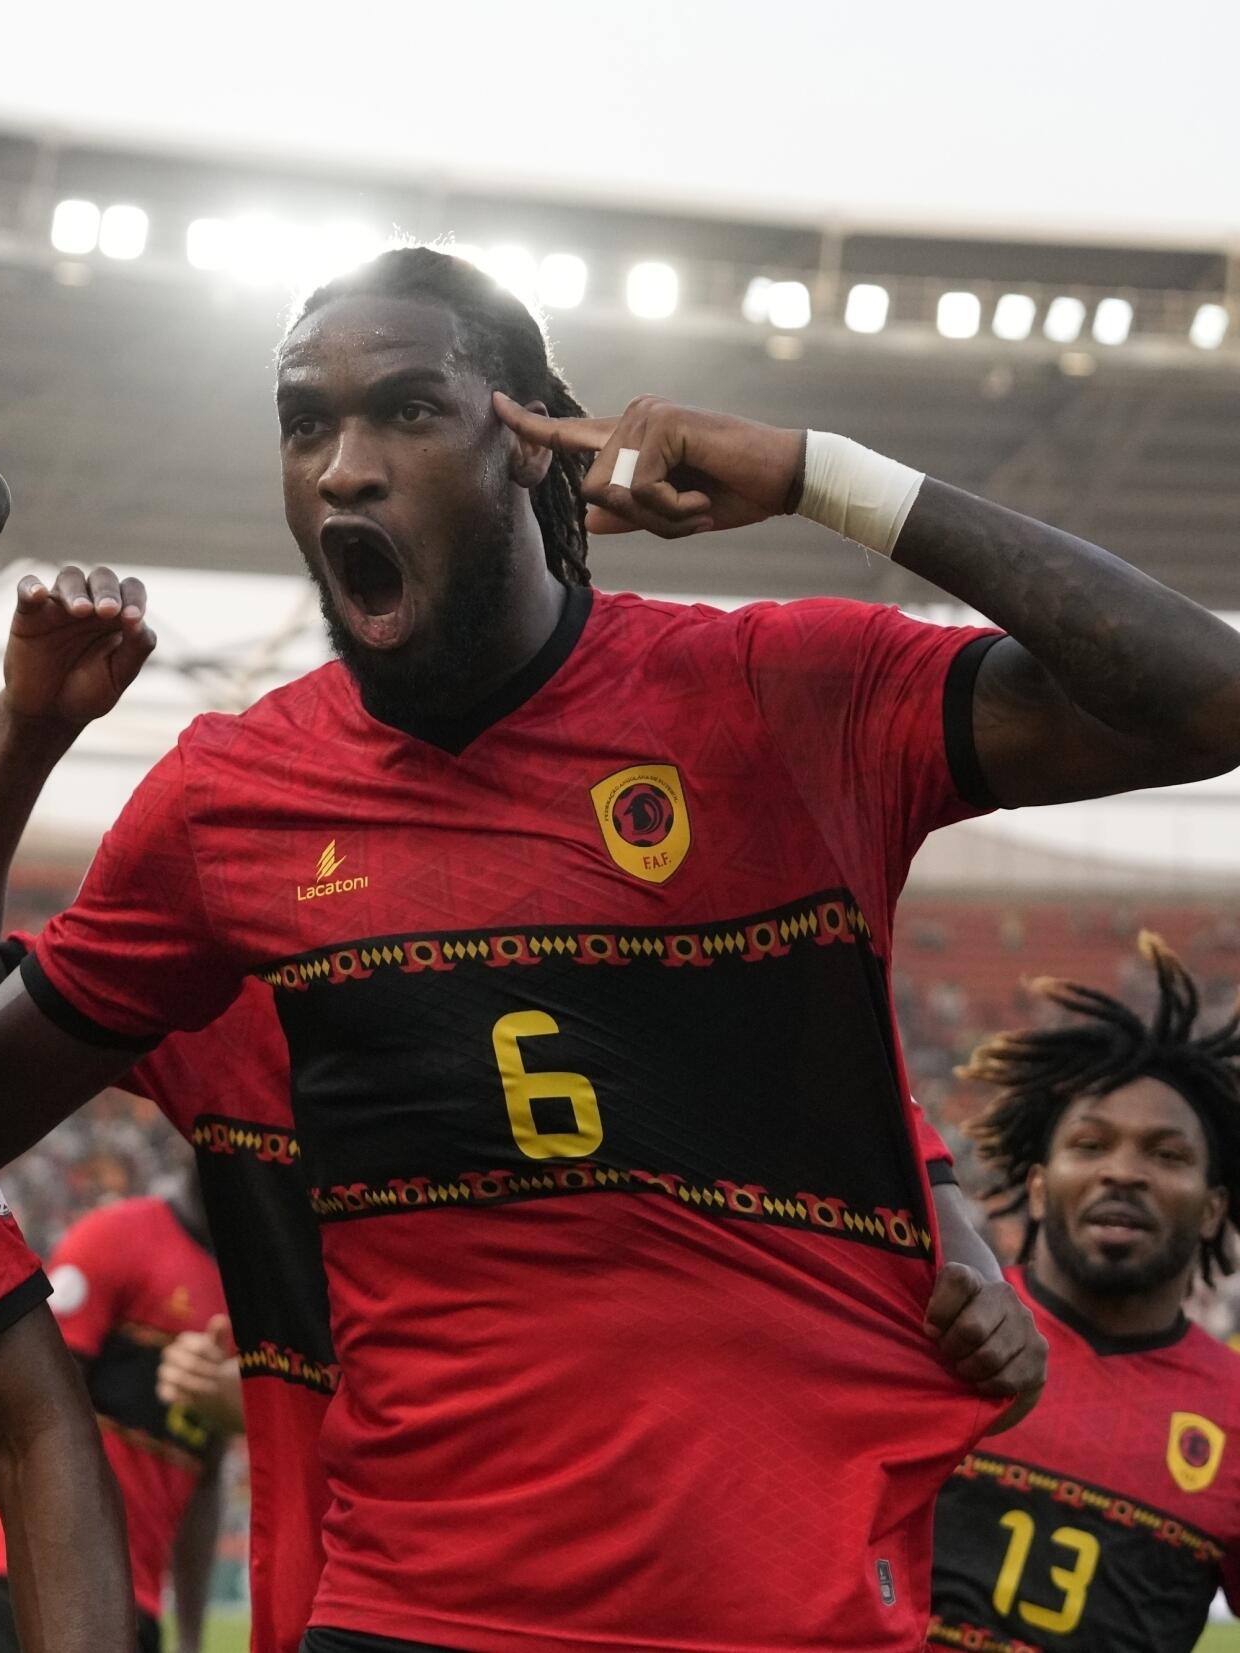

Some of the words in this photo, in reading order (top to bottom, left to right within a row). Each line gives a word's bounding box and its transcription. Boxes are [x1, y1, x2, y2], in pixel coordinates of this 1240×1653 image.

[297, 876, 368, 901] Lacatoni
[492, 1010, 603, 1159] 6
[991, 1509, 1101, 1634] 13
